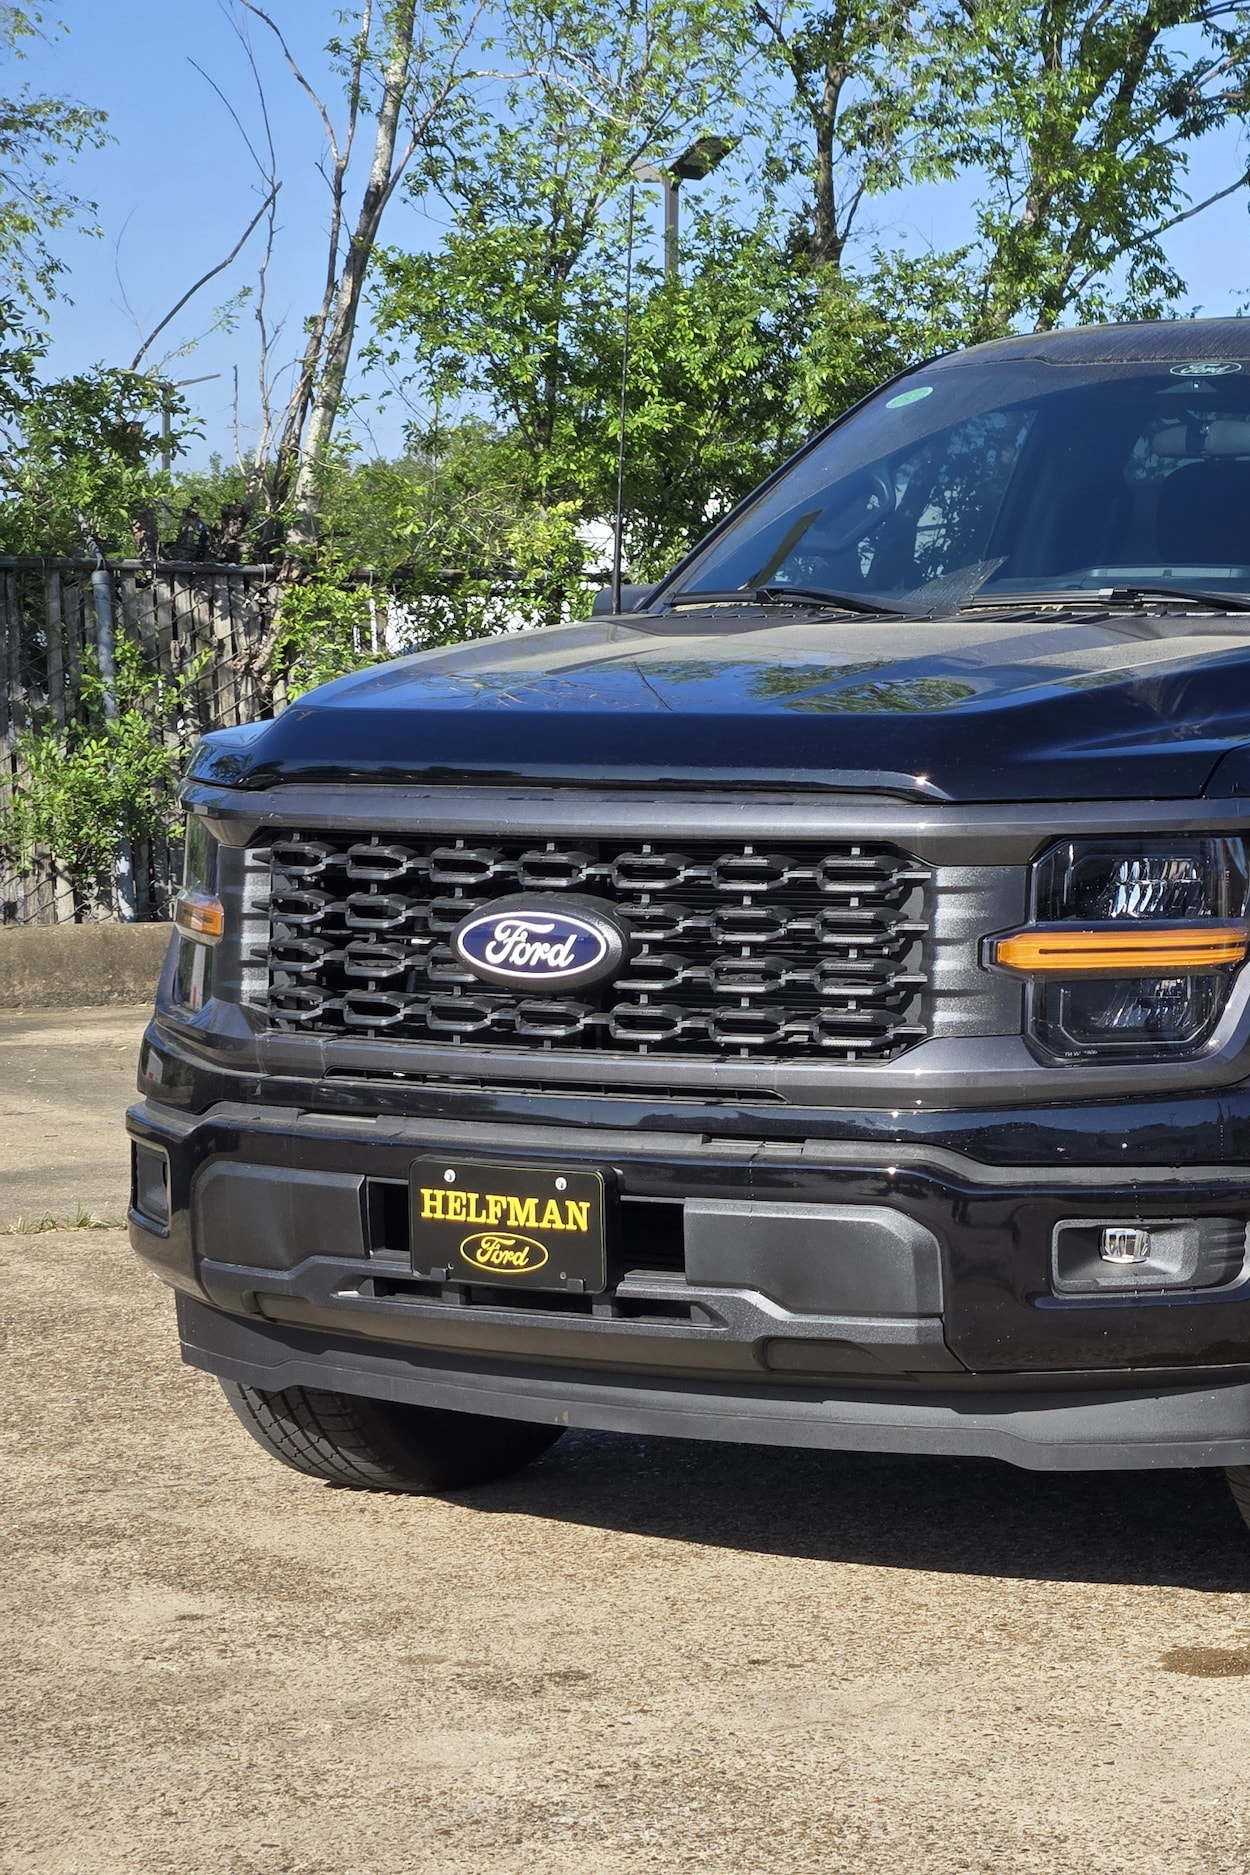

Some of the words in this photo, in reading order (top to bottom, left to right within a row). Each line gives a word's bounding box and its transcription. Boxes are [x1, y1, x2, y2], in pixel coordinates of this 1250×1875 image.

[1180, 362, 1231, 374] Ford
[485, 919, 578, 968] Ford
[419, 1187, 591, 1232] HELFMAN
[475, 1234, 530, 1267] Ford
